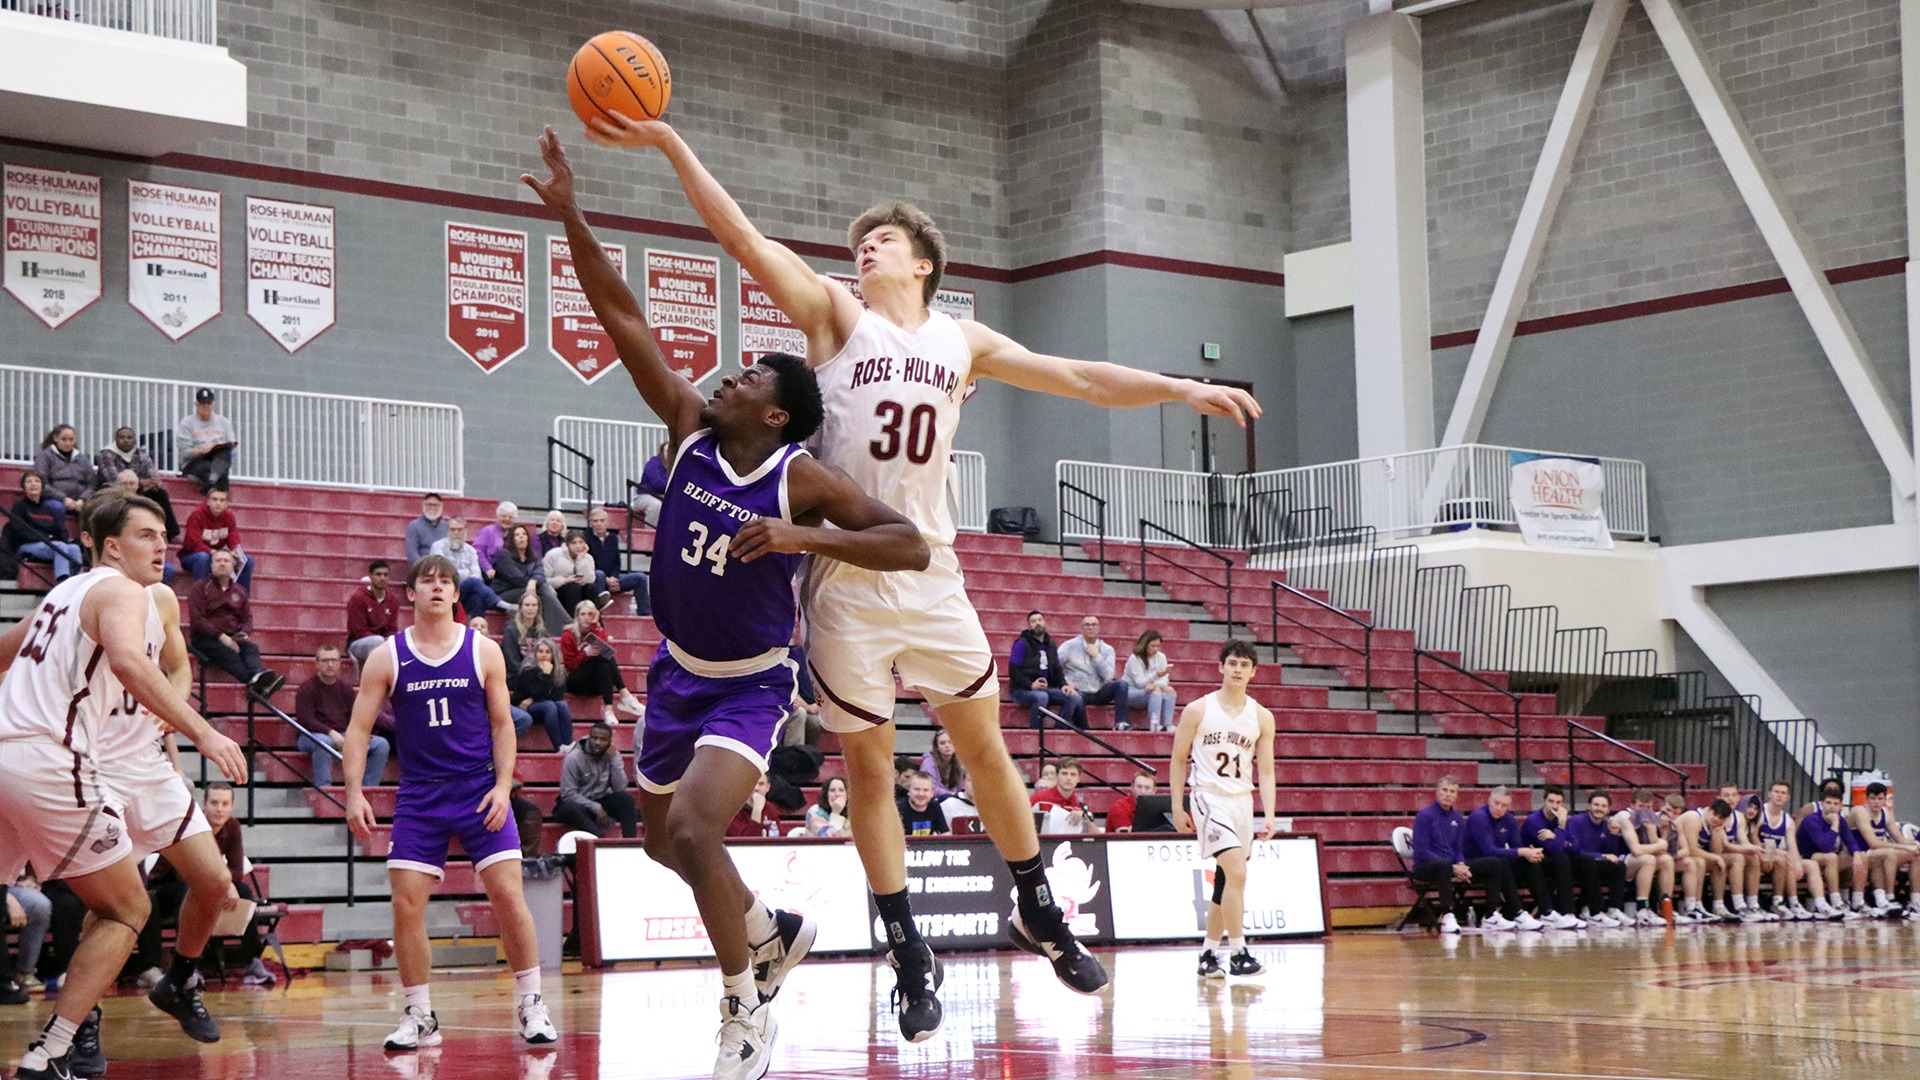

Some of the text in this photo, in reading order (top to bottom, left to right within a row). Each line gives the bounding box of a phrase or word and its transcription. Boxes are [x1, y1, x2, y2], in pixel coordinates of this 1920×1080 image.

[7, 171, 98, 192] ROSE-HULMAN
[132, 186, 217, 207] ROSE-HULMAN
[6, 195, 99, 220] VOLLEYBALL
[250, 204, 331, 224] ROSE-HULMAN
[15, 220, 90, 239] TOURNAMENT
[132, 212, 217, 233] VOLLEYBALL
[8, 232, 96, 257] CHAMPIONS
[134, 233, 217, 250] TOURNAMENT
[249, 226, 333, 250] VOLLEYBALL
[450, 229, 523, 249] ROSE-HULMAN
[133, 242, 217, 266] CHAMPIONS
[251, 249, 331, 268] REGULAR SEASON
[460, 251, 513, 269] WOMEN'S
[22, 261, 85, 278] Heartland
[147, 263, 207, 279] Heartland
[251, 261, 331, 285] CHAMPIONS
[451, 263, 523, 282] BASKETBALL
[649, 256, 715, 273] ROSE-HULMAN
[43, 288, 66, 300] 2018
[453, 280, 522, 294] REGULAR SEASON
[659, 277, 707, 293] WOMEN'S
[163, 293, 187, 303] 2011
[264, 289, 320, 305] Heartland
[453, 288, 522, 308] CHAMPIONS
[650, 288, 716, 305] BASKETBALL
[462, 306, 515, 320] Heartland
[555, 301, 593, 313] CHAMP
[653, 303, 713, 317] TOURNAMENT
[742, 305, 792, 323] BASKETB
[282, 315, 300, 325] 2011
[652, 312, 716, 330] CHAMPIONS
[476, 328, 499, 338] 2016
[661, 328, 708, 342] Heartland
[745, 325, 775, 335] REGULAR
[577, 339, 599, 349] 2017
[744, 335, 806, 353] CHAMPIONS
[673, 349, 694, 359] 2017
[869, 400, 937, 465] 30
[1534, 469, 1580, 487] UNION
[1531, 485, 1583, 504] HEALTH
[681, 520, 732, 577] 34
[406, 678, 470, 692] BLUFFTON
[427, 697, 452, 727] 11
[1216, 752, 1241, 778] 21
